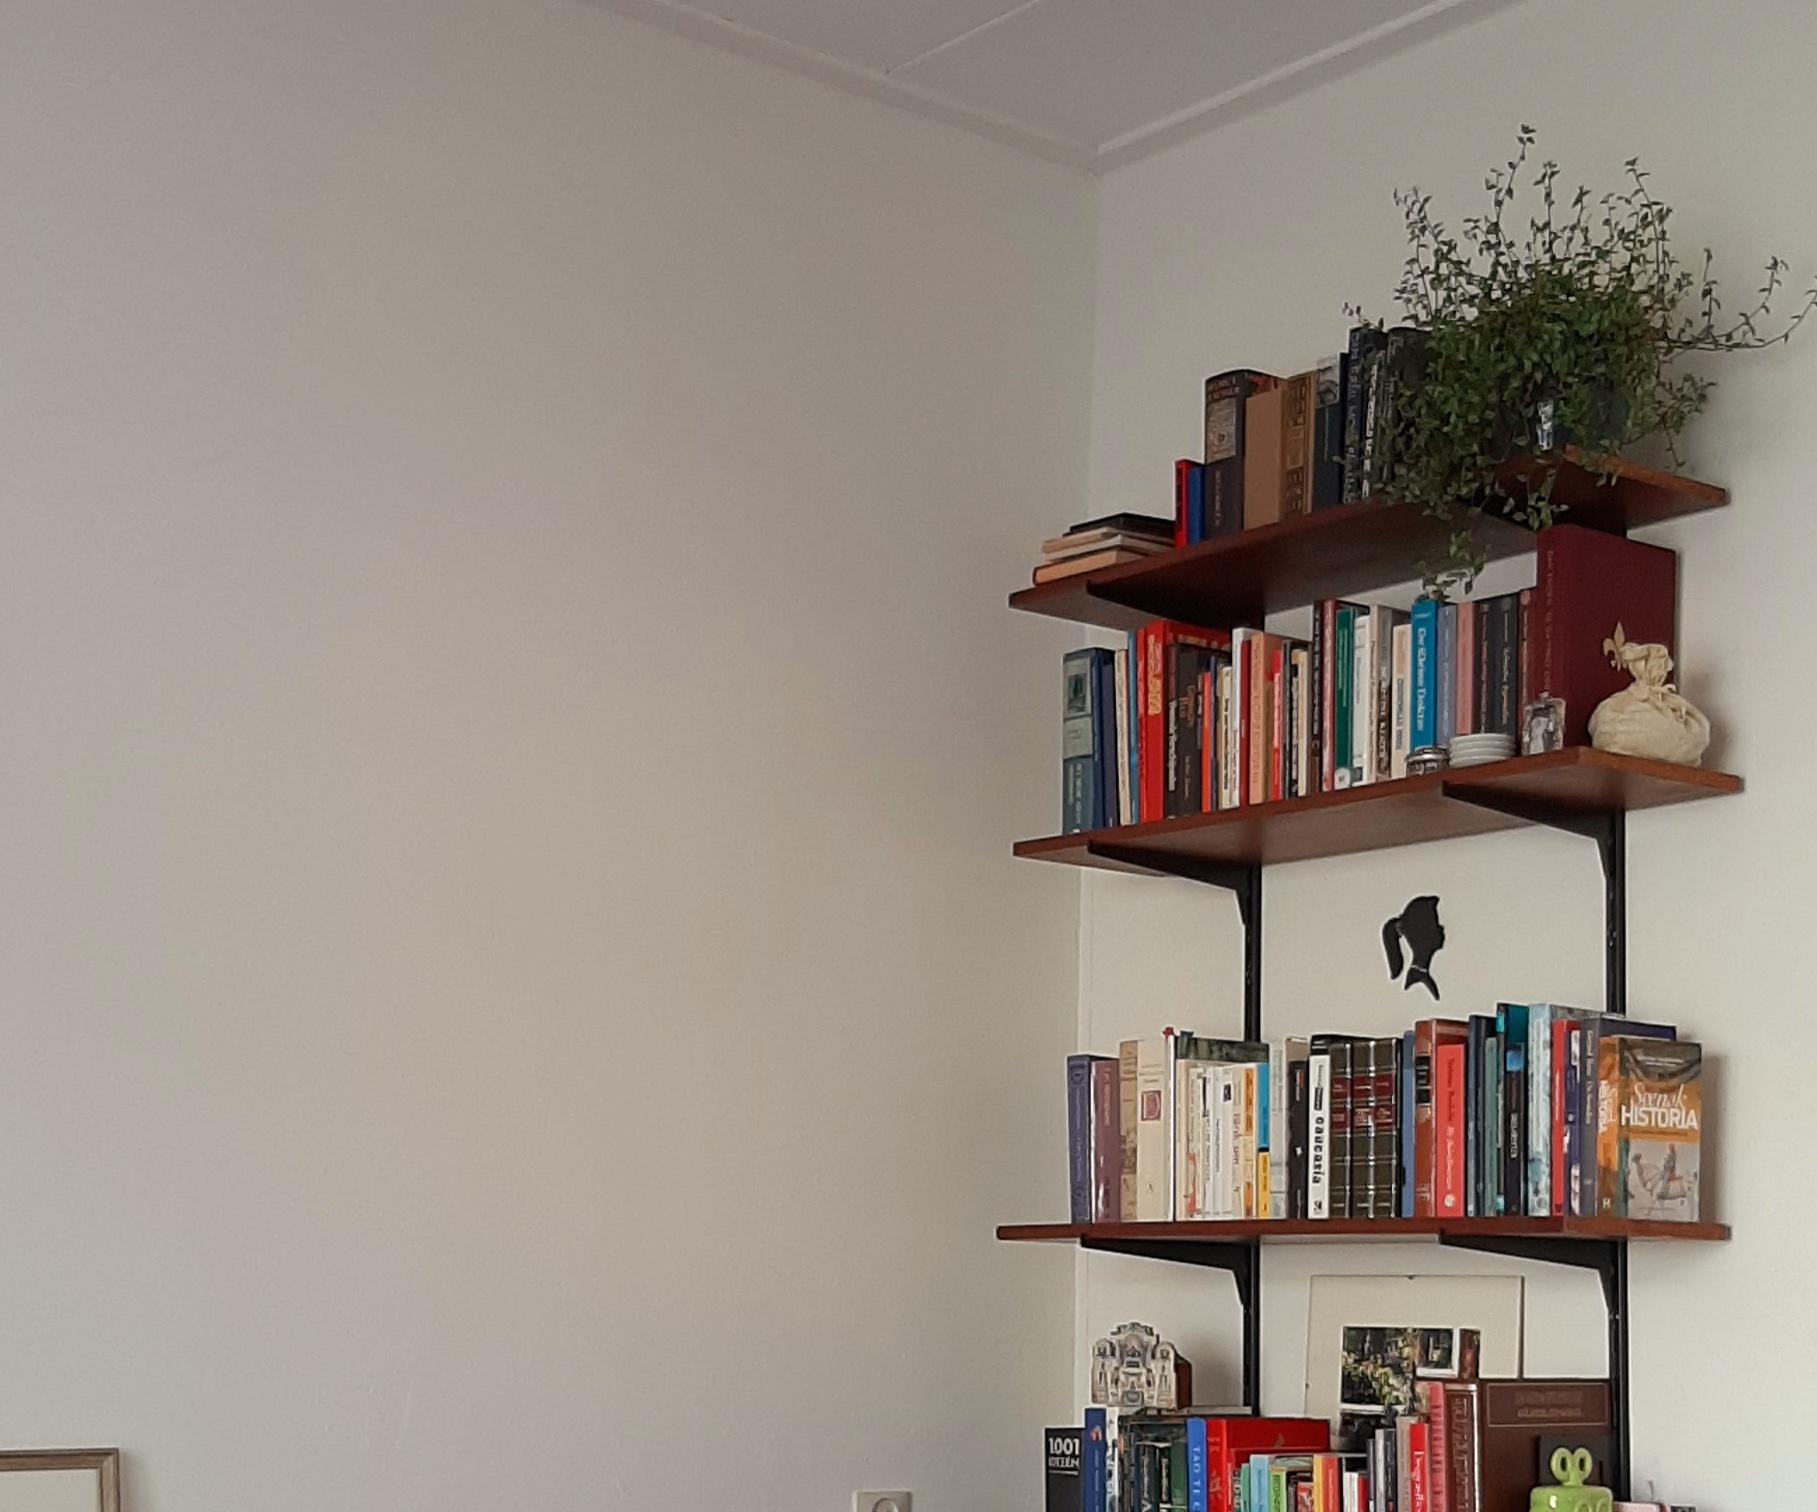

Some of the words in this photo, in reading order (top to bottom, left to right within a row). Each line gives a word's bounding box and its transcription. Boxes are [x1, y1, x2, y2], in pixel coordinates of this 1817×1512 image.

[1621, 1103, 1698, 1130] HISTORIA
[1048, 1437, 1080, 1456] 1001
[1191, 1446, 1202, 1473] TAO
